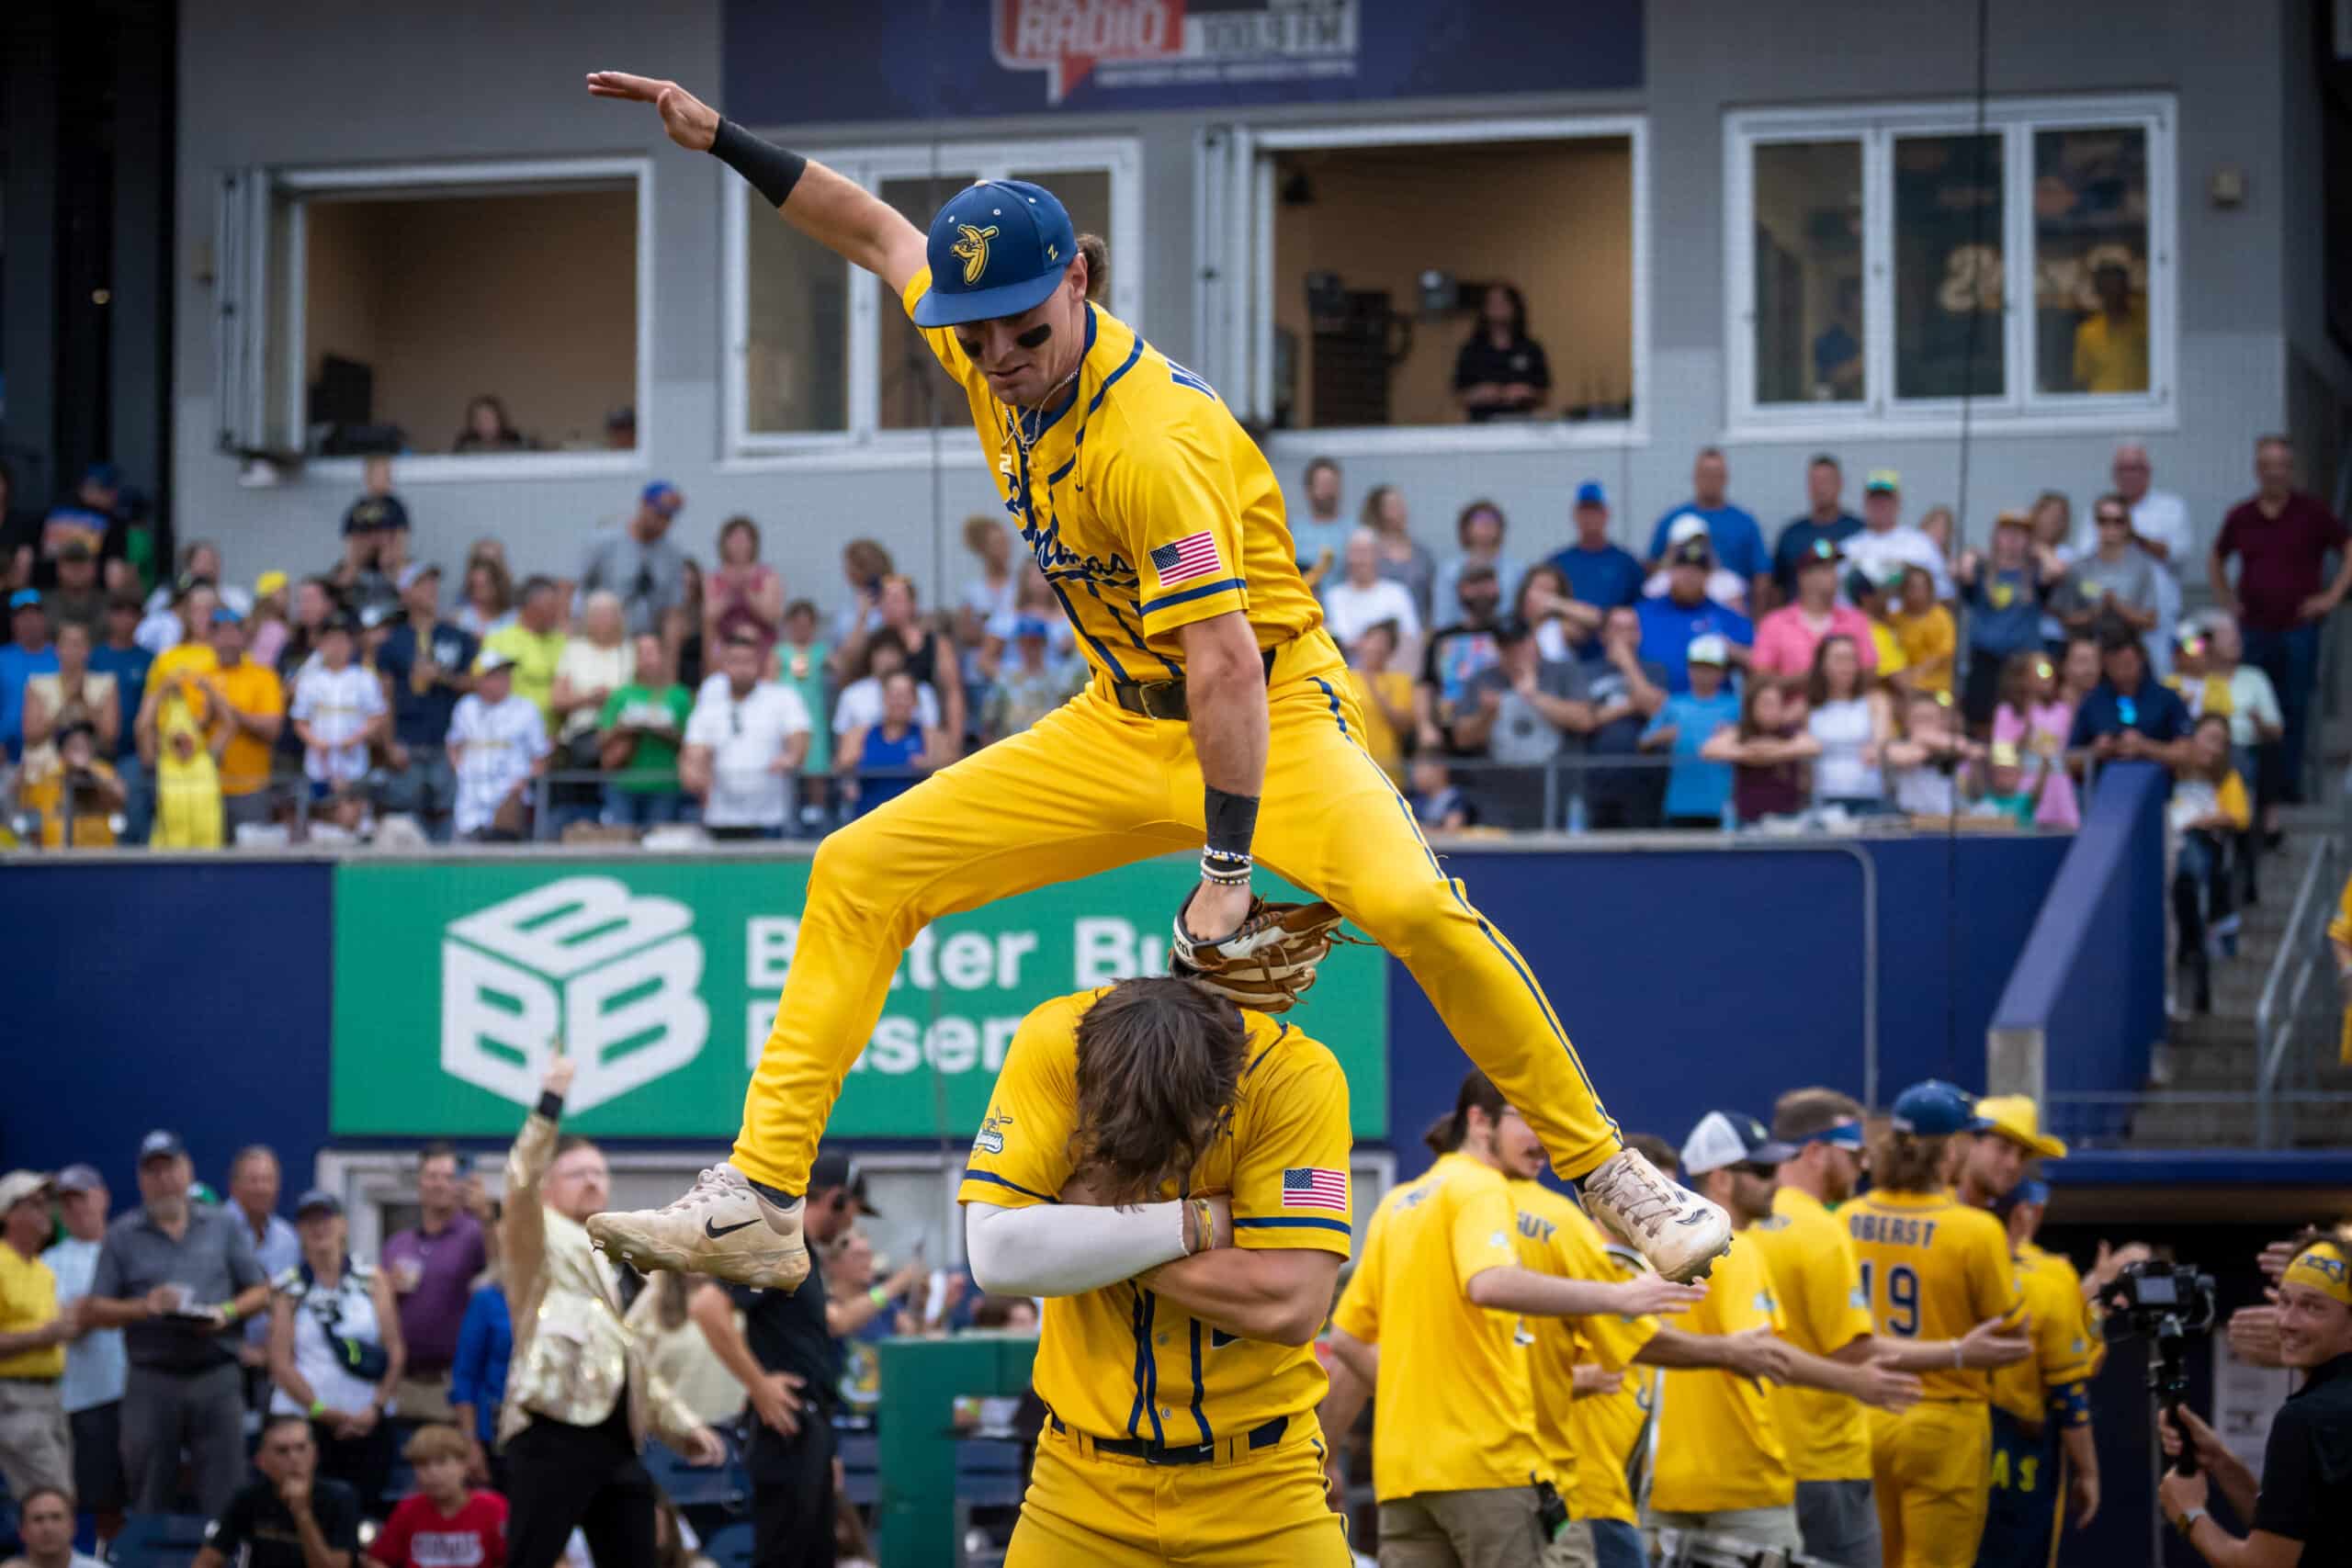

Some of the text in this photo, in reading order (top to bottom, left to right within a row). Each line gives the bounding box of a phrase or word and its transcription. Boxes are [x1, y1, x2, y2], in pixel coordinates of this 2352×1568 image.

[745, 915, 1038, 990] Bter
[1849, 1213, 1938, 1250] OBERST
[1860, 1259, 1921, 1337] 19
